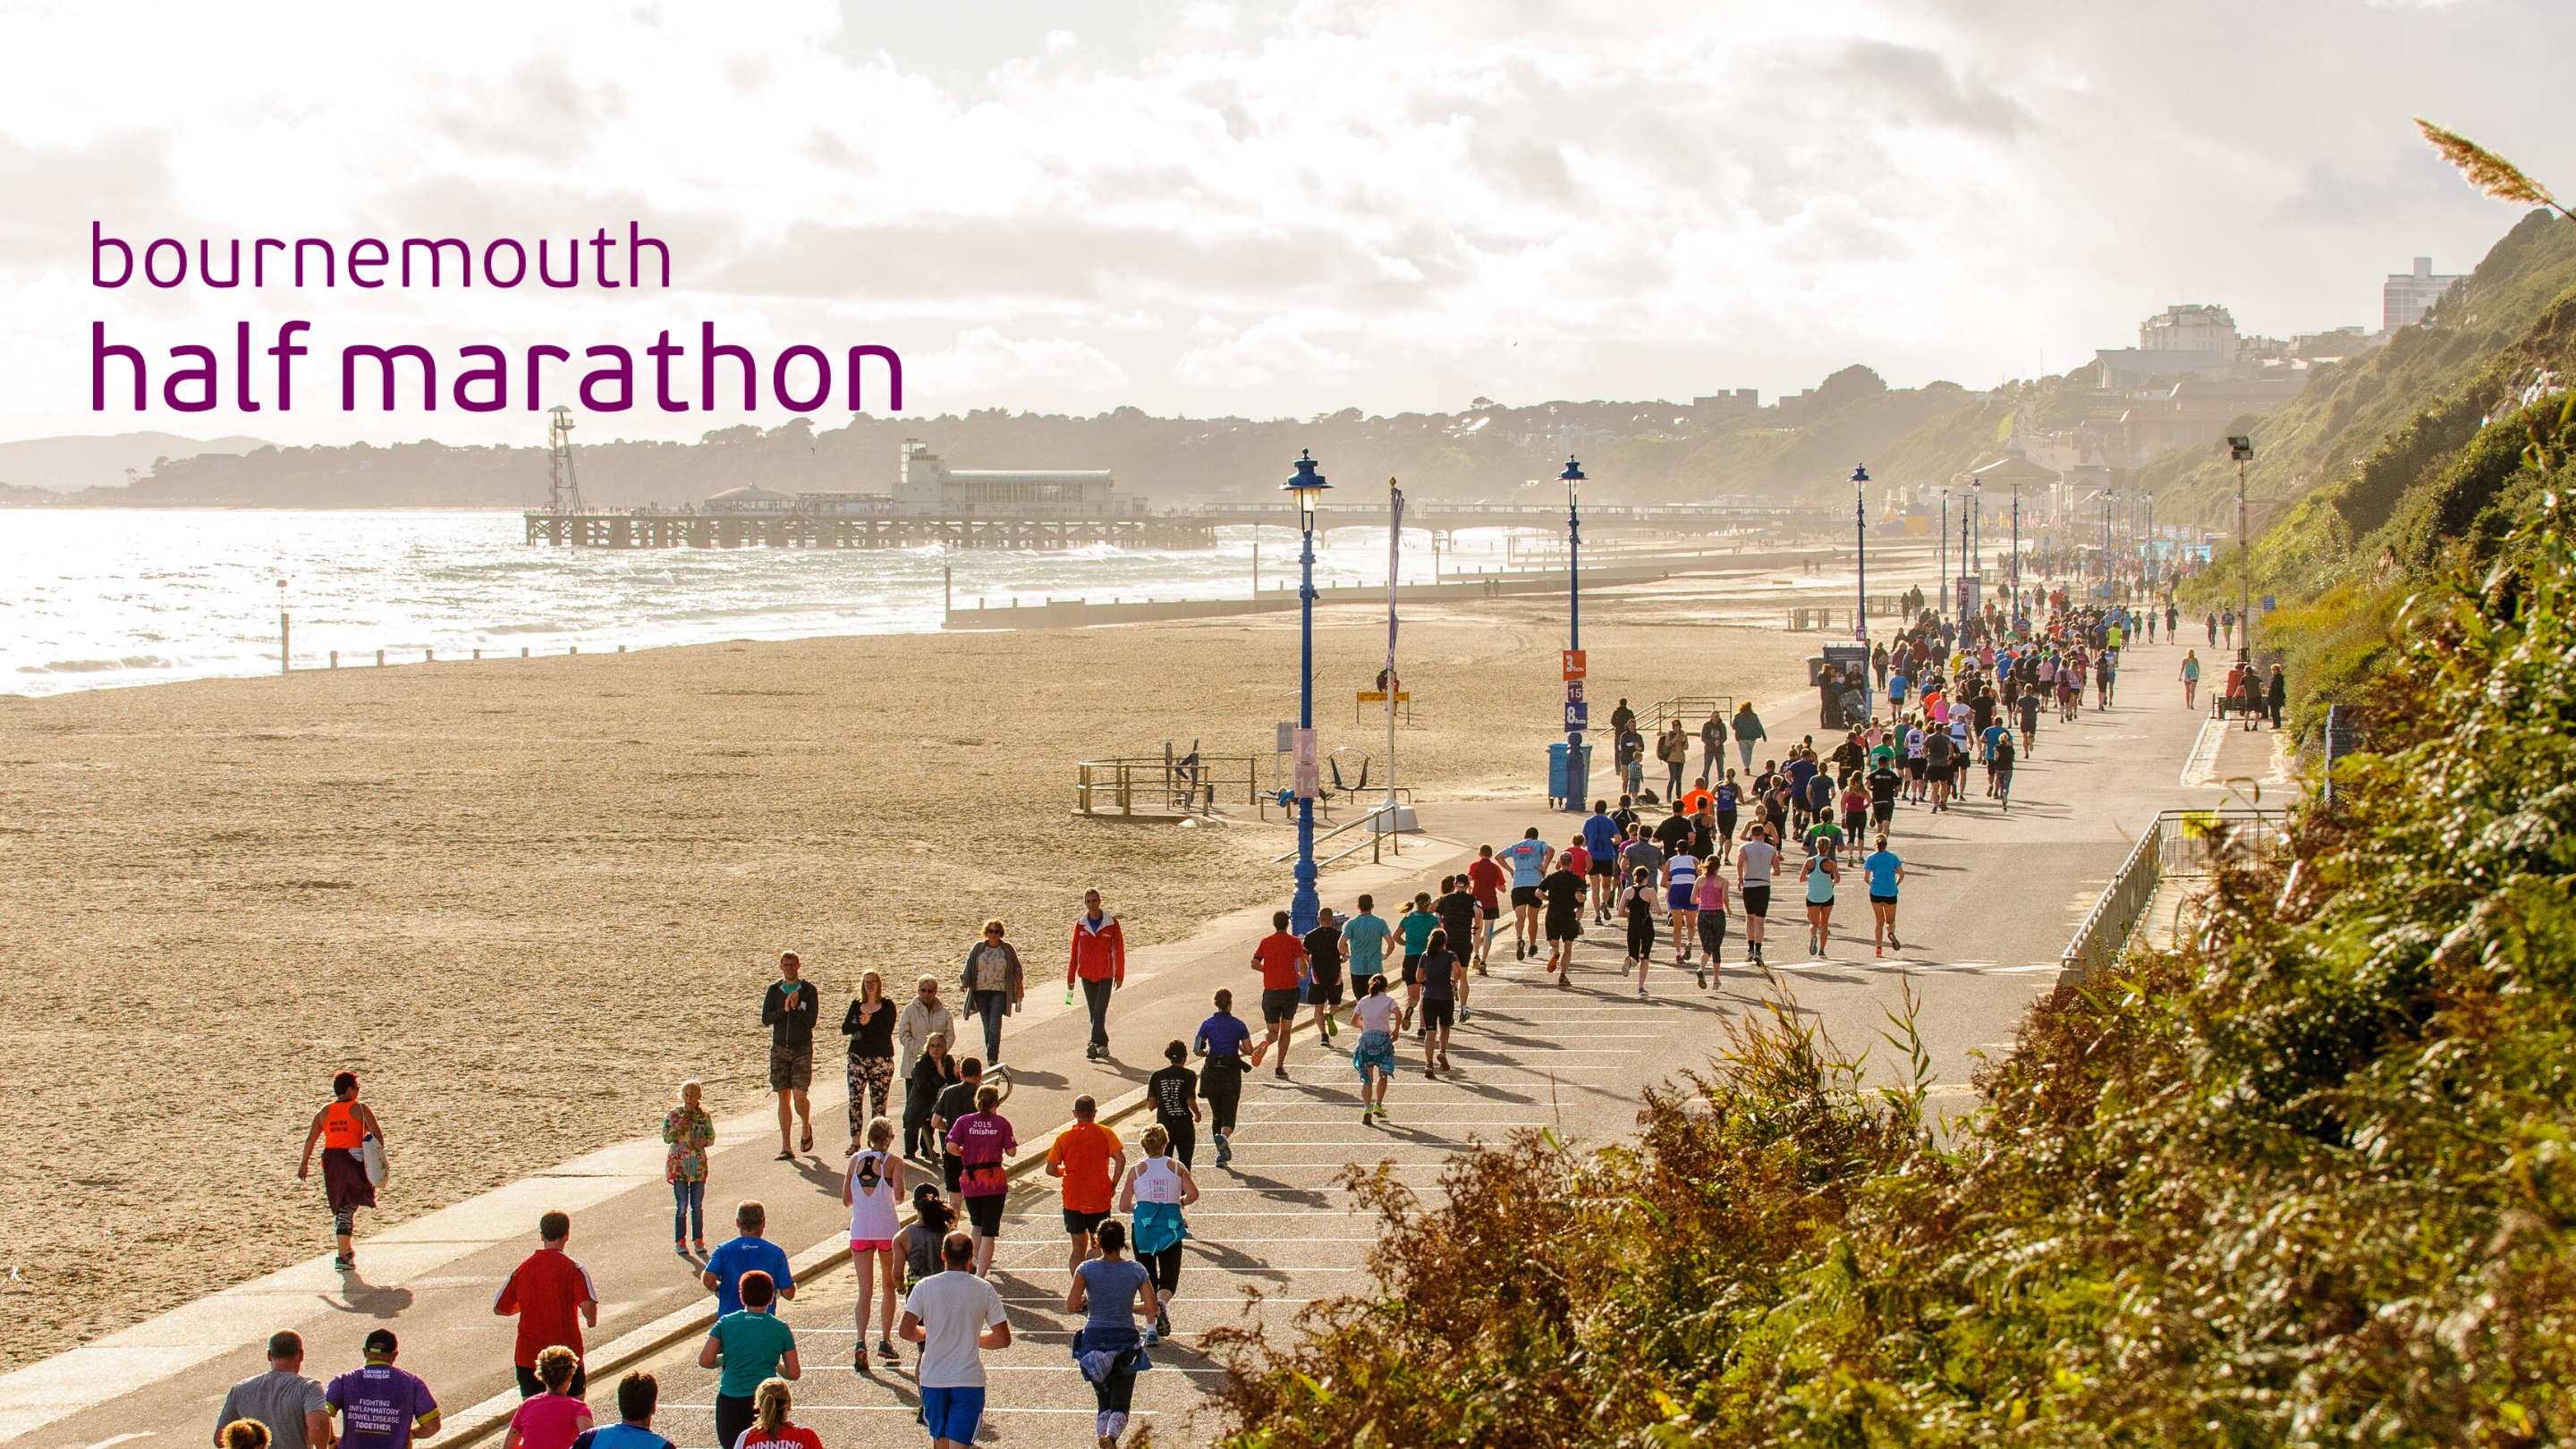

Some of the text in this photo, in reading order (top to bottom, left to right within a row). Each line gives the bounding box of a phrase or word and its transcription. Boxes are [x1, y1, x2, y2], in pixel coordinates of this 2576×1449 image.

[1856, 631, 1865, 640] 16
[1568, 688, 1582, 699] 15
[1295, 741, 1316, 758] 14
[1298, 776, 1318, 792] 14
[969, 1127, 998, 1135] finisher
[359, 1398, 390, 1407] FIGHTING
[349, 1405, 400, 1415] INFLAMMATORY
[348, 1412, 400, 1423] BOWEL DISEASE
[355, 1420, 392, 1431] TOGETHER
